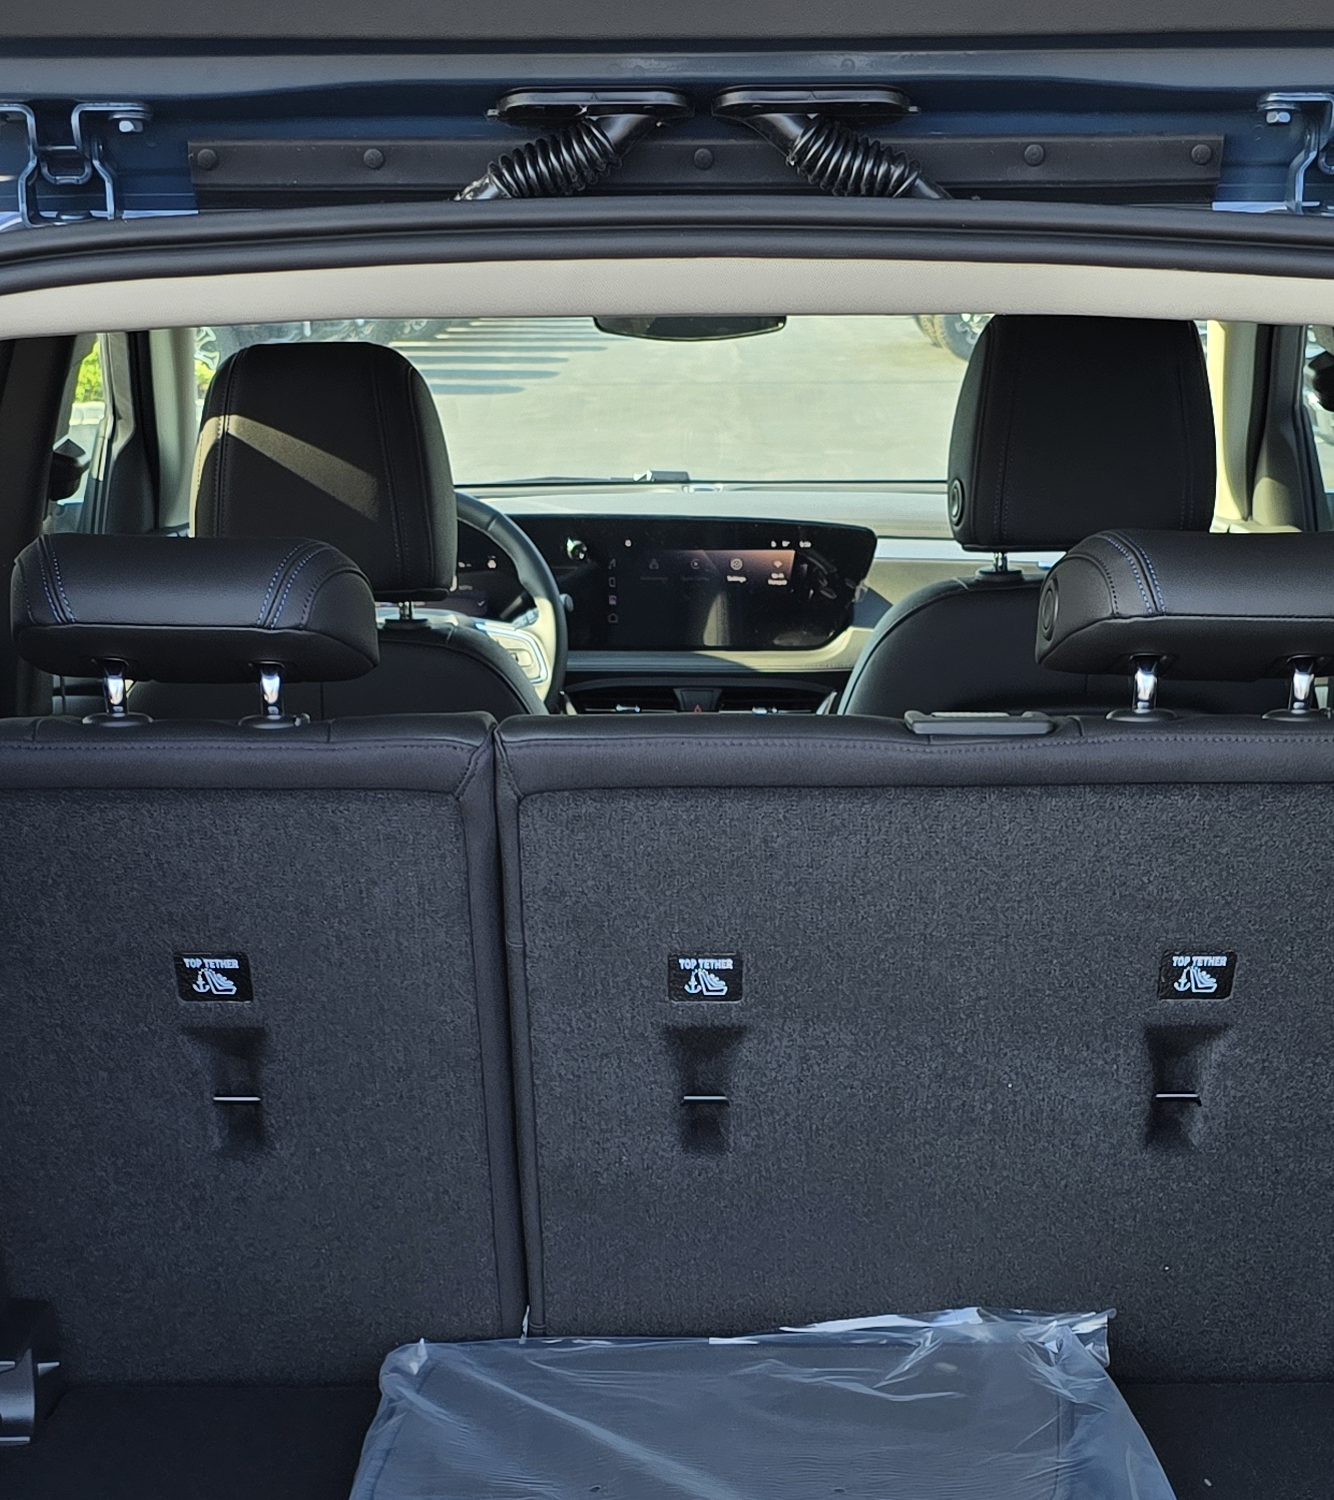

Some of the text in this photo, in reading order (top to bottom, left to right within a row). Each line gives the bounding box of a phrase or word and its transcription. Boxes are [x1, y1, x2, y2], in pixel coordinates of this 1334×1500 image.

[182, 957, 239, 969] TOP TETHER
[679, 958, 734, 970] TOP TETHER
[1172, 956, 1227, 967] TOP TETHER
